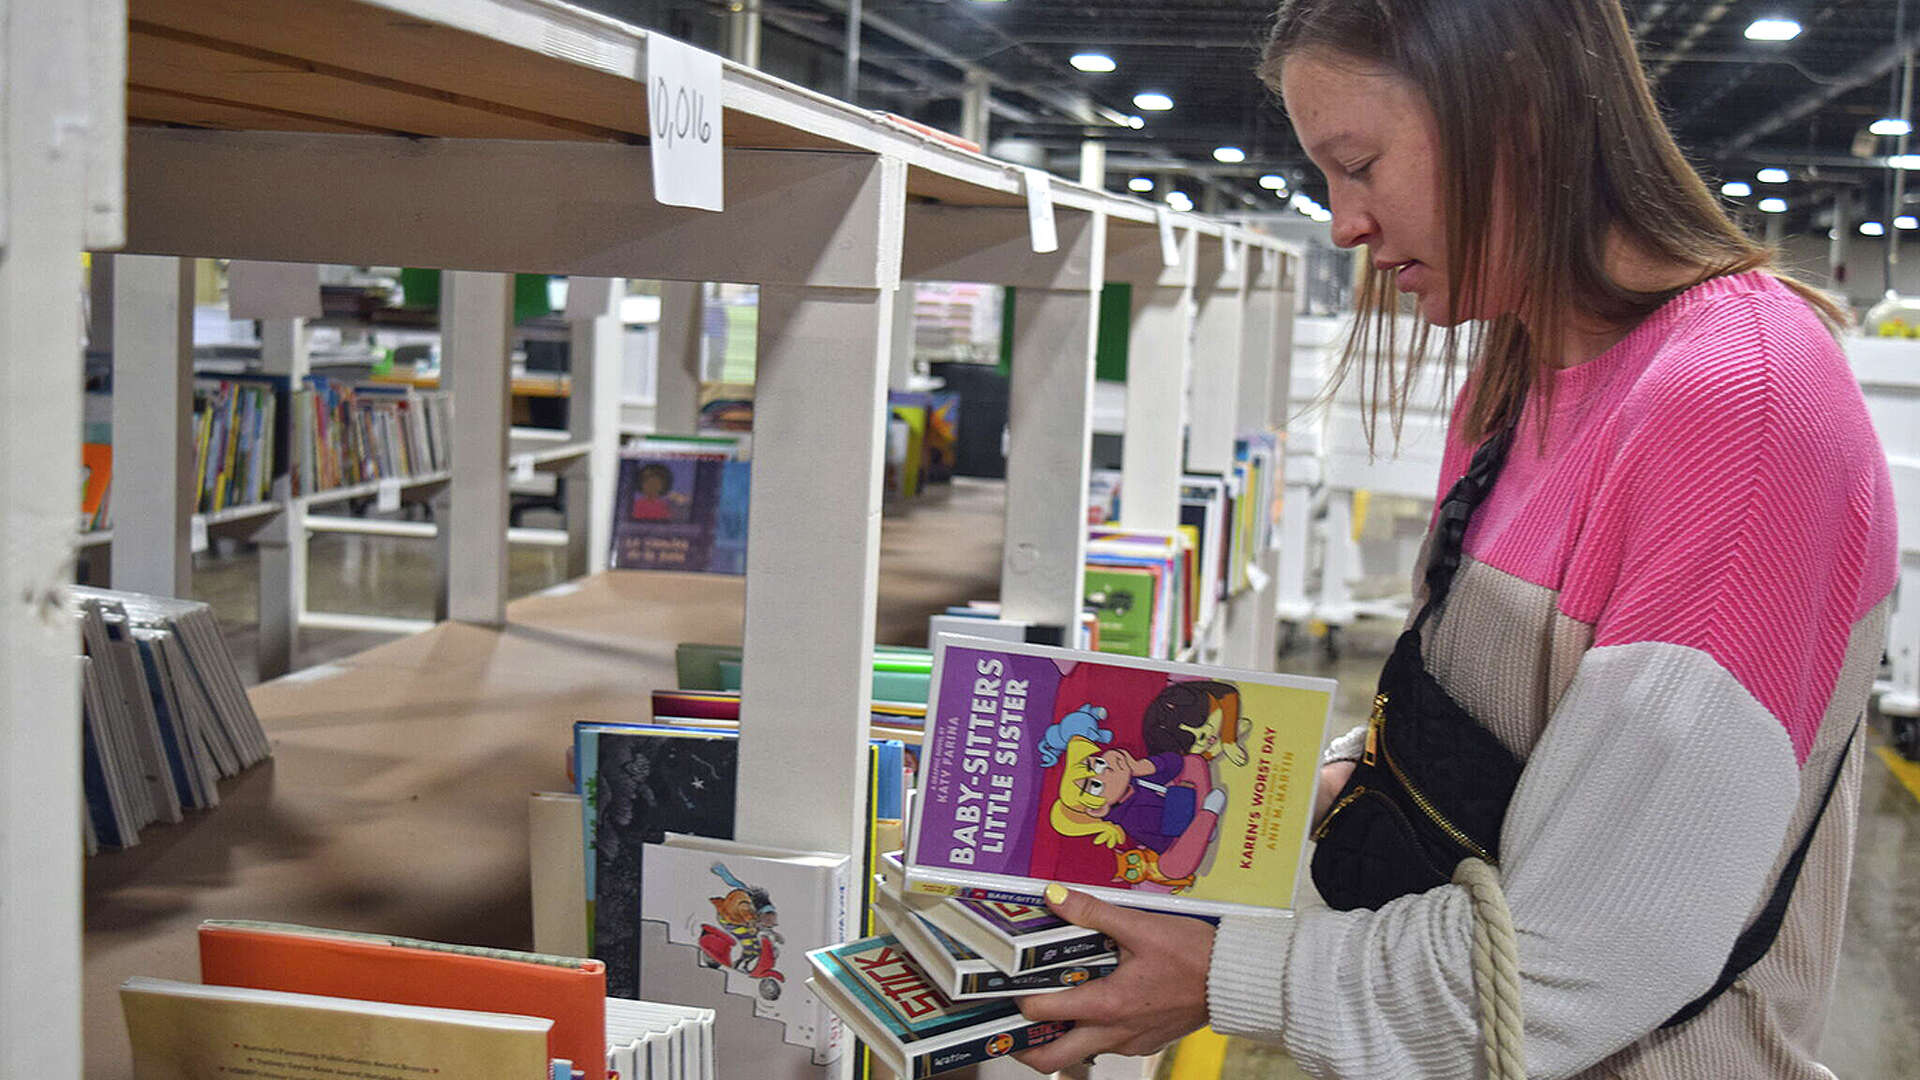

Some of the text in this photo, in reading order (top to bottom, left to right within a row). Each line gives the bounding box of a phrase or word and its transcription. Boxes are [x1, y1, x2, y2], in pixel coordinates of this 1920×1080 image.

[936, 717, 960, 803] KATY FARINA
[949, 658, 1004, 865] BABY-SITTERS
[981, 679, 1029, 853] LITTLE SISTER
[1239, 812, 1261, 869] KAREN'S
[1251, 757, 1271, 807] WORST
[1261, 726, 1276, 754] DAY
[1266, 822, 1281, 850] ANN
[1275, 751, 1294, 802] MARTIN
[853, 947, 953, 1019] STICK
